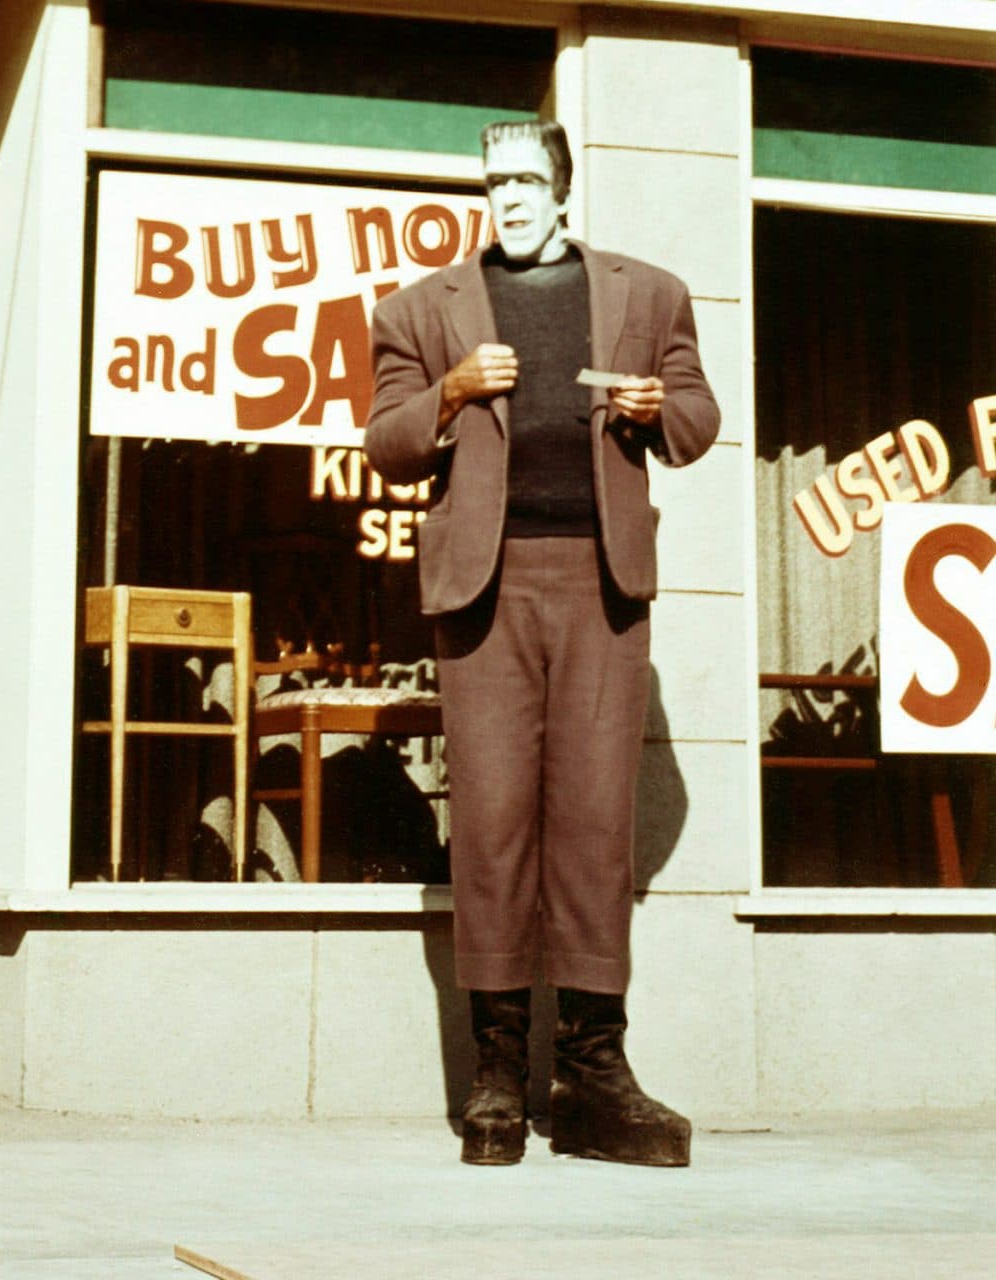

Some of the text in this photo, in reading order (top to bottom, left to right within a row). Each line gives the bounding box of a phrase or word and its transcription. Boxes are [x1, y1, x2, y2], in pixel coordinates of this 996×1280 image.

[107, 281, 399, 431] and SA
[358, 508, 428, 560] SE
[793, 419, 950, 558] USED
